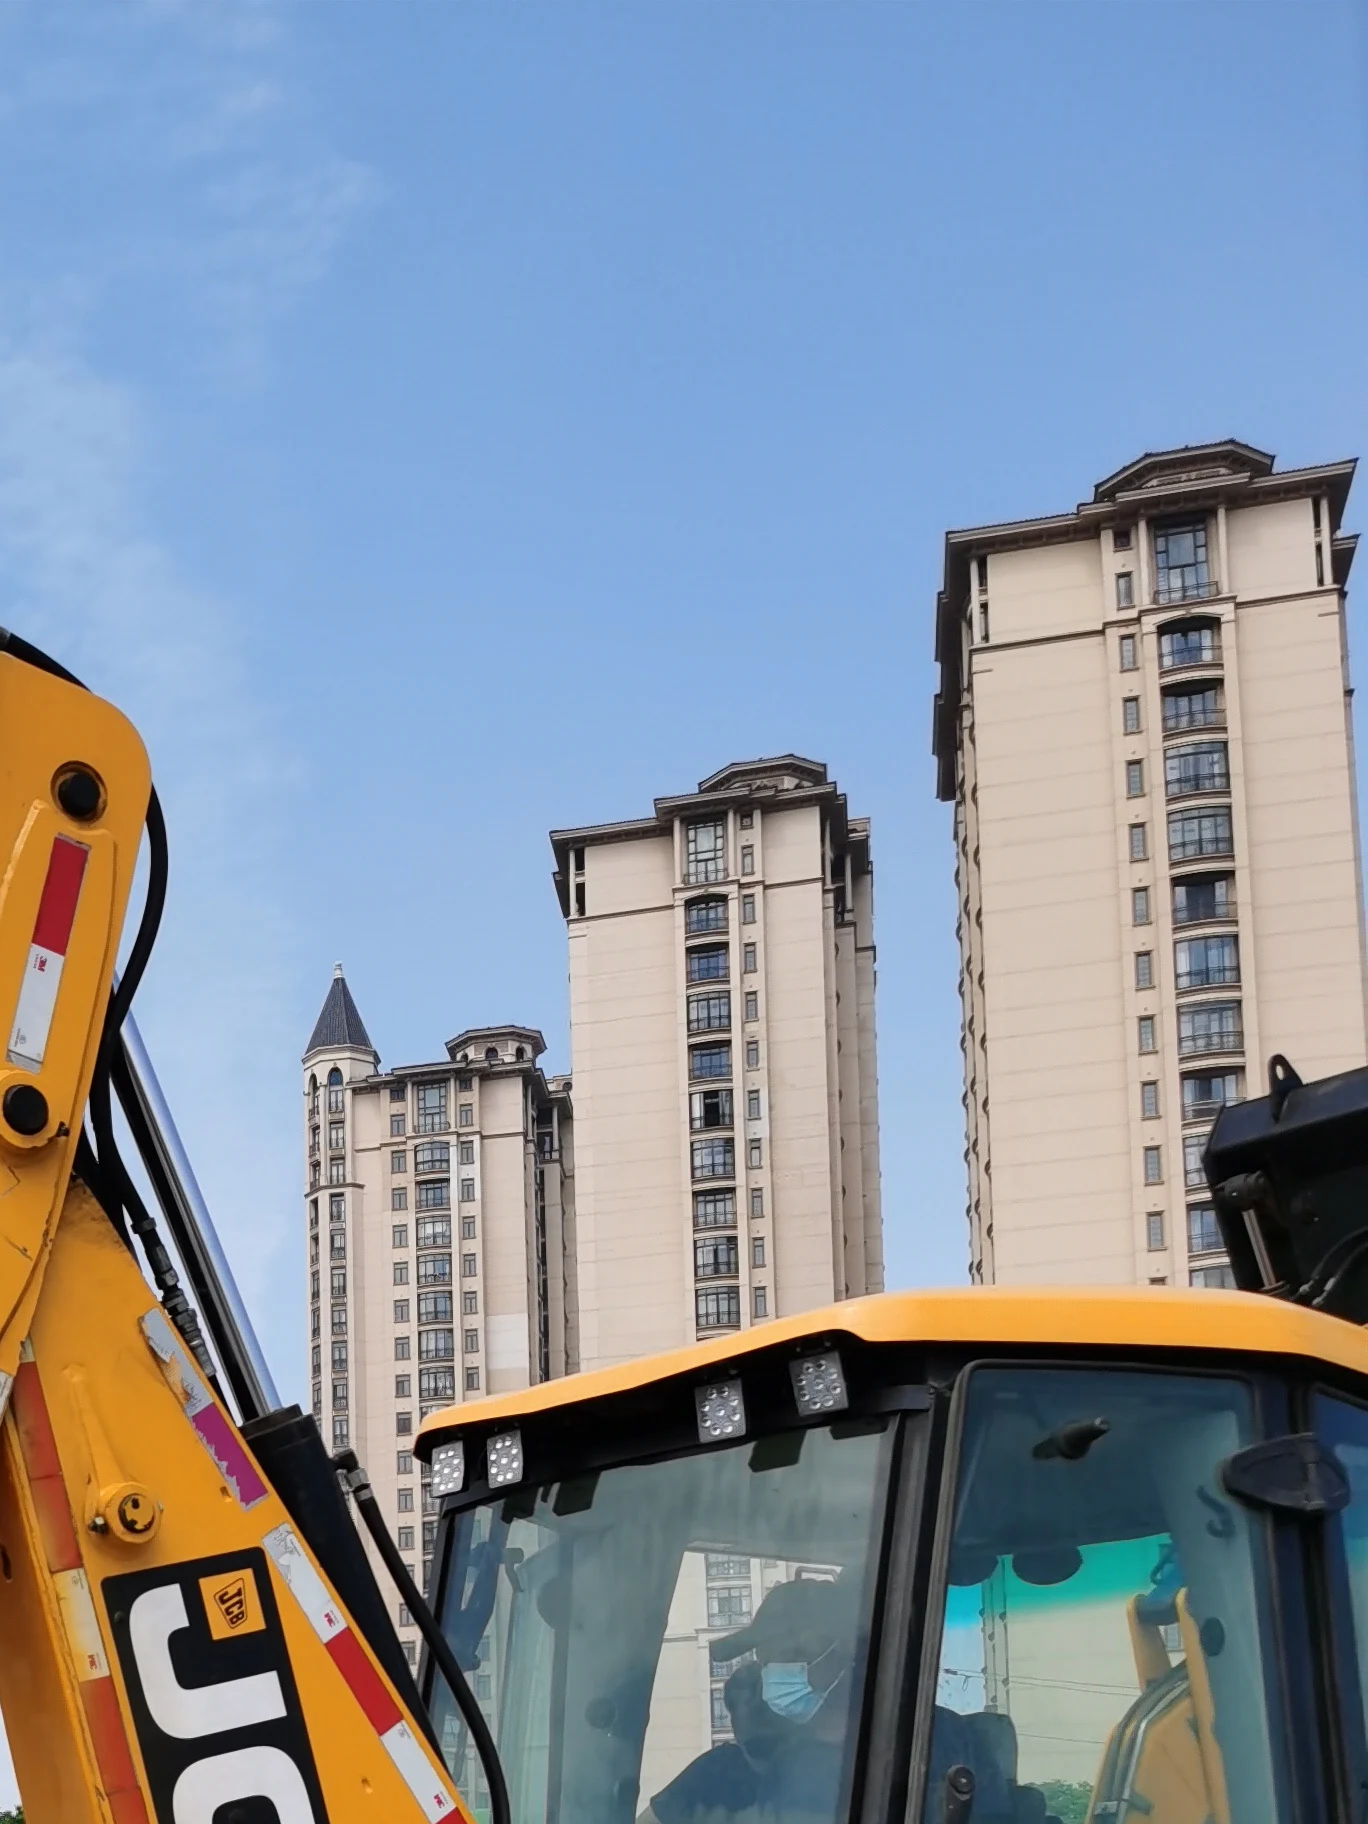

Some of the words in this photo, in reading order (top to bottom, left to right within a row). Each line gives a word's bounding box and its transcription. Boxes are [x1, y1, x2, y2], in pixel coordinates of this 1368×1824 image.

[38, 956, 47, 972] 3M
[218, 1587, 245, 1625] JCB
[324, 1612, 335, 1627] 3M
[88, 1654, 97, 1670] 3M
[434, 1794, 444, 1809] 3M
